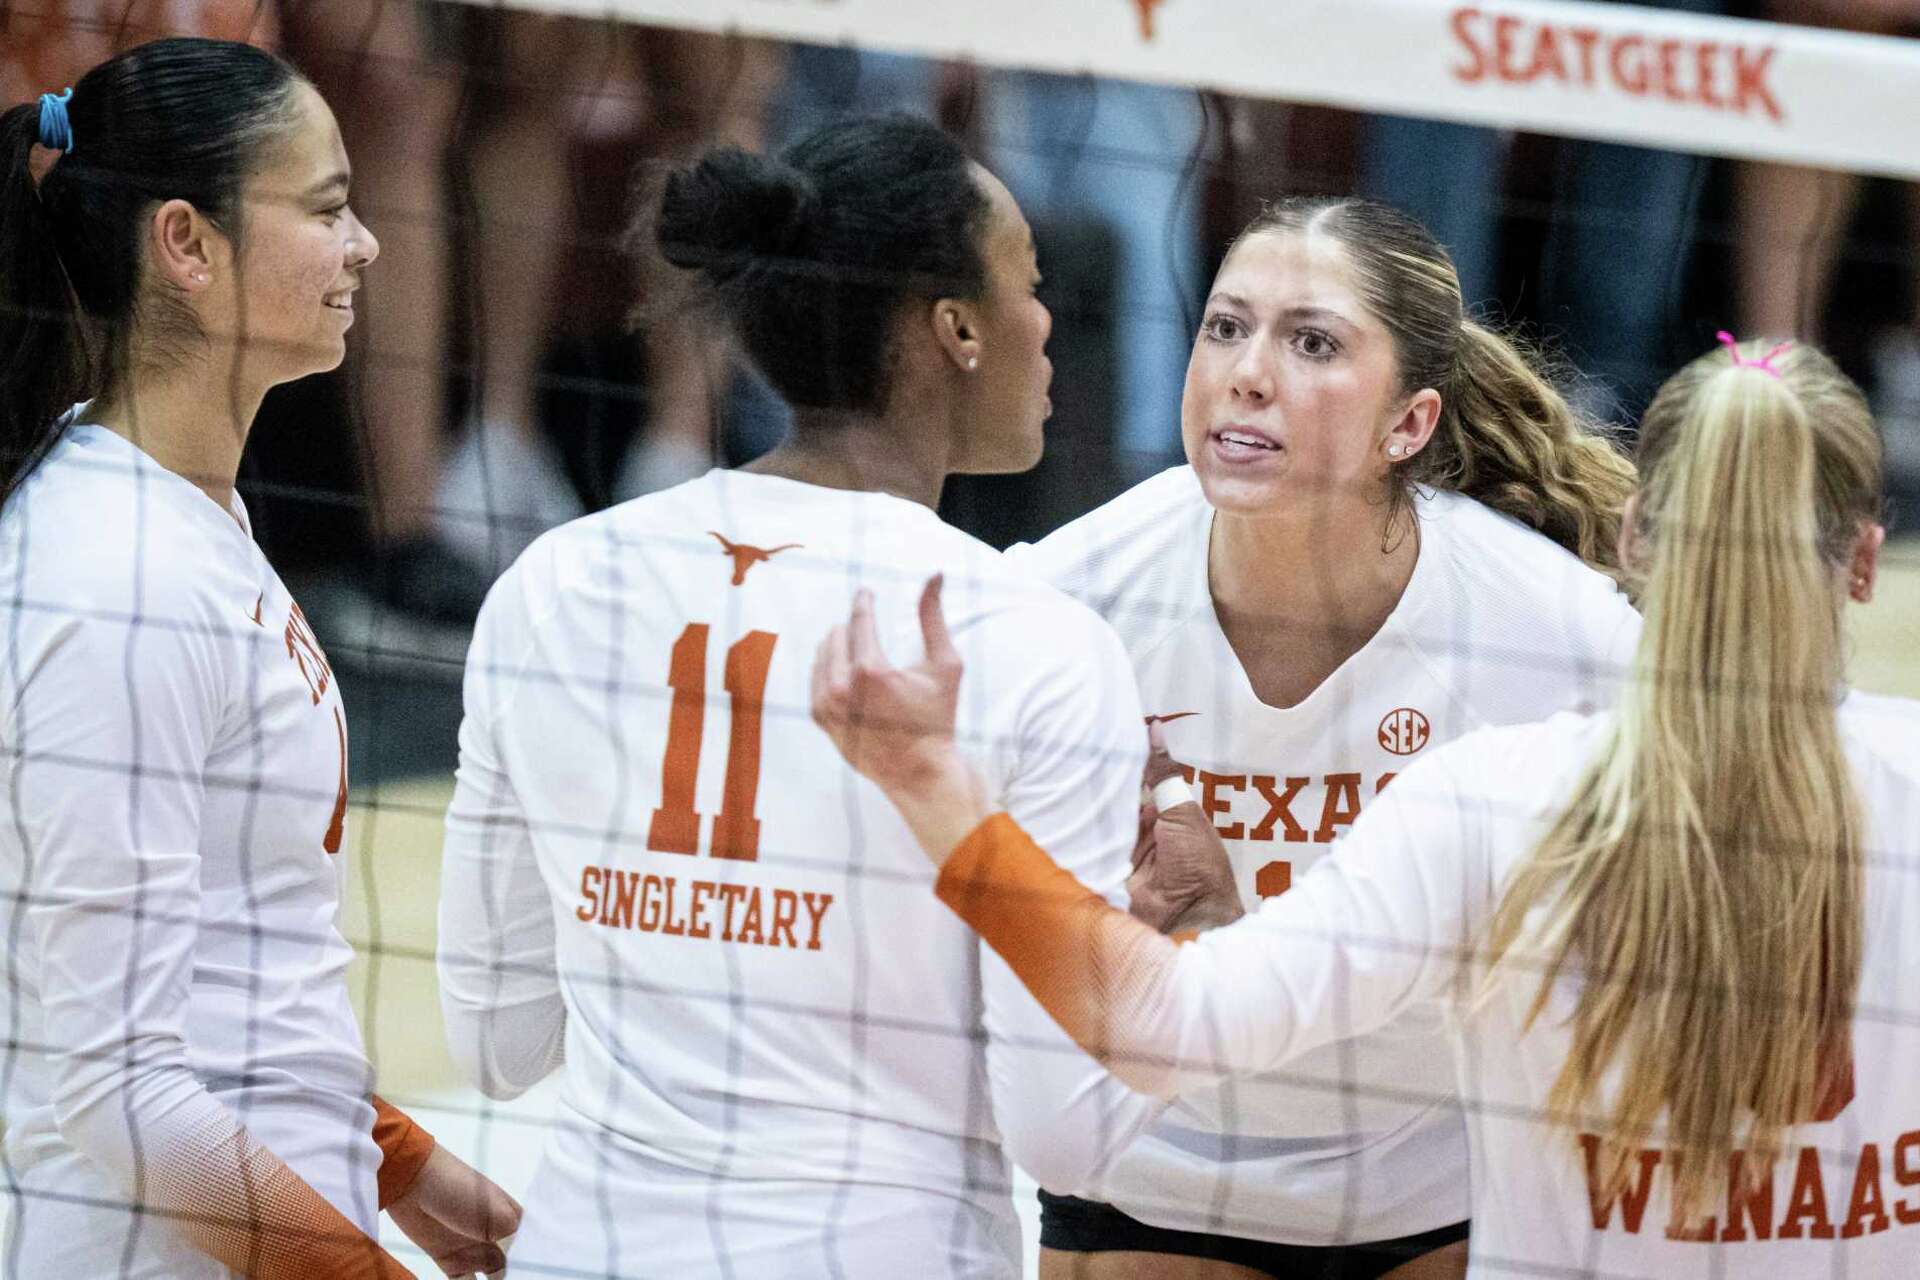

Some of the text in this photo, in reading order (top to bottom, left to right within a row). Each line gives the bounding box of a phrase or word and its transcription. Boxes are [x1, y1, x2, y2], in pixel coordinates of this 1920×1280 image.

[1452, 7, 1783, 121] SEATGEEK
[647, 622, 778, 861] 11
[1378, 708, 1429, 754] SEC
[1168, 763, 1398, 843] EXA
[576, 866, 833, 950] SINGLETARY
